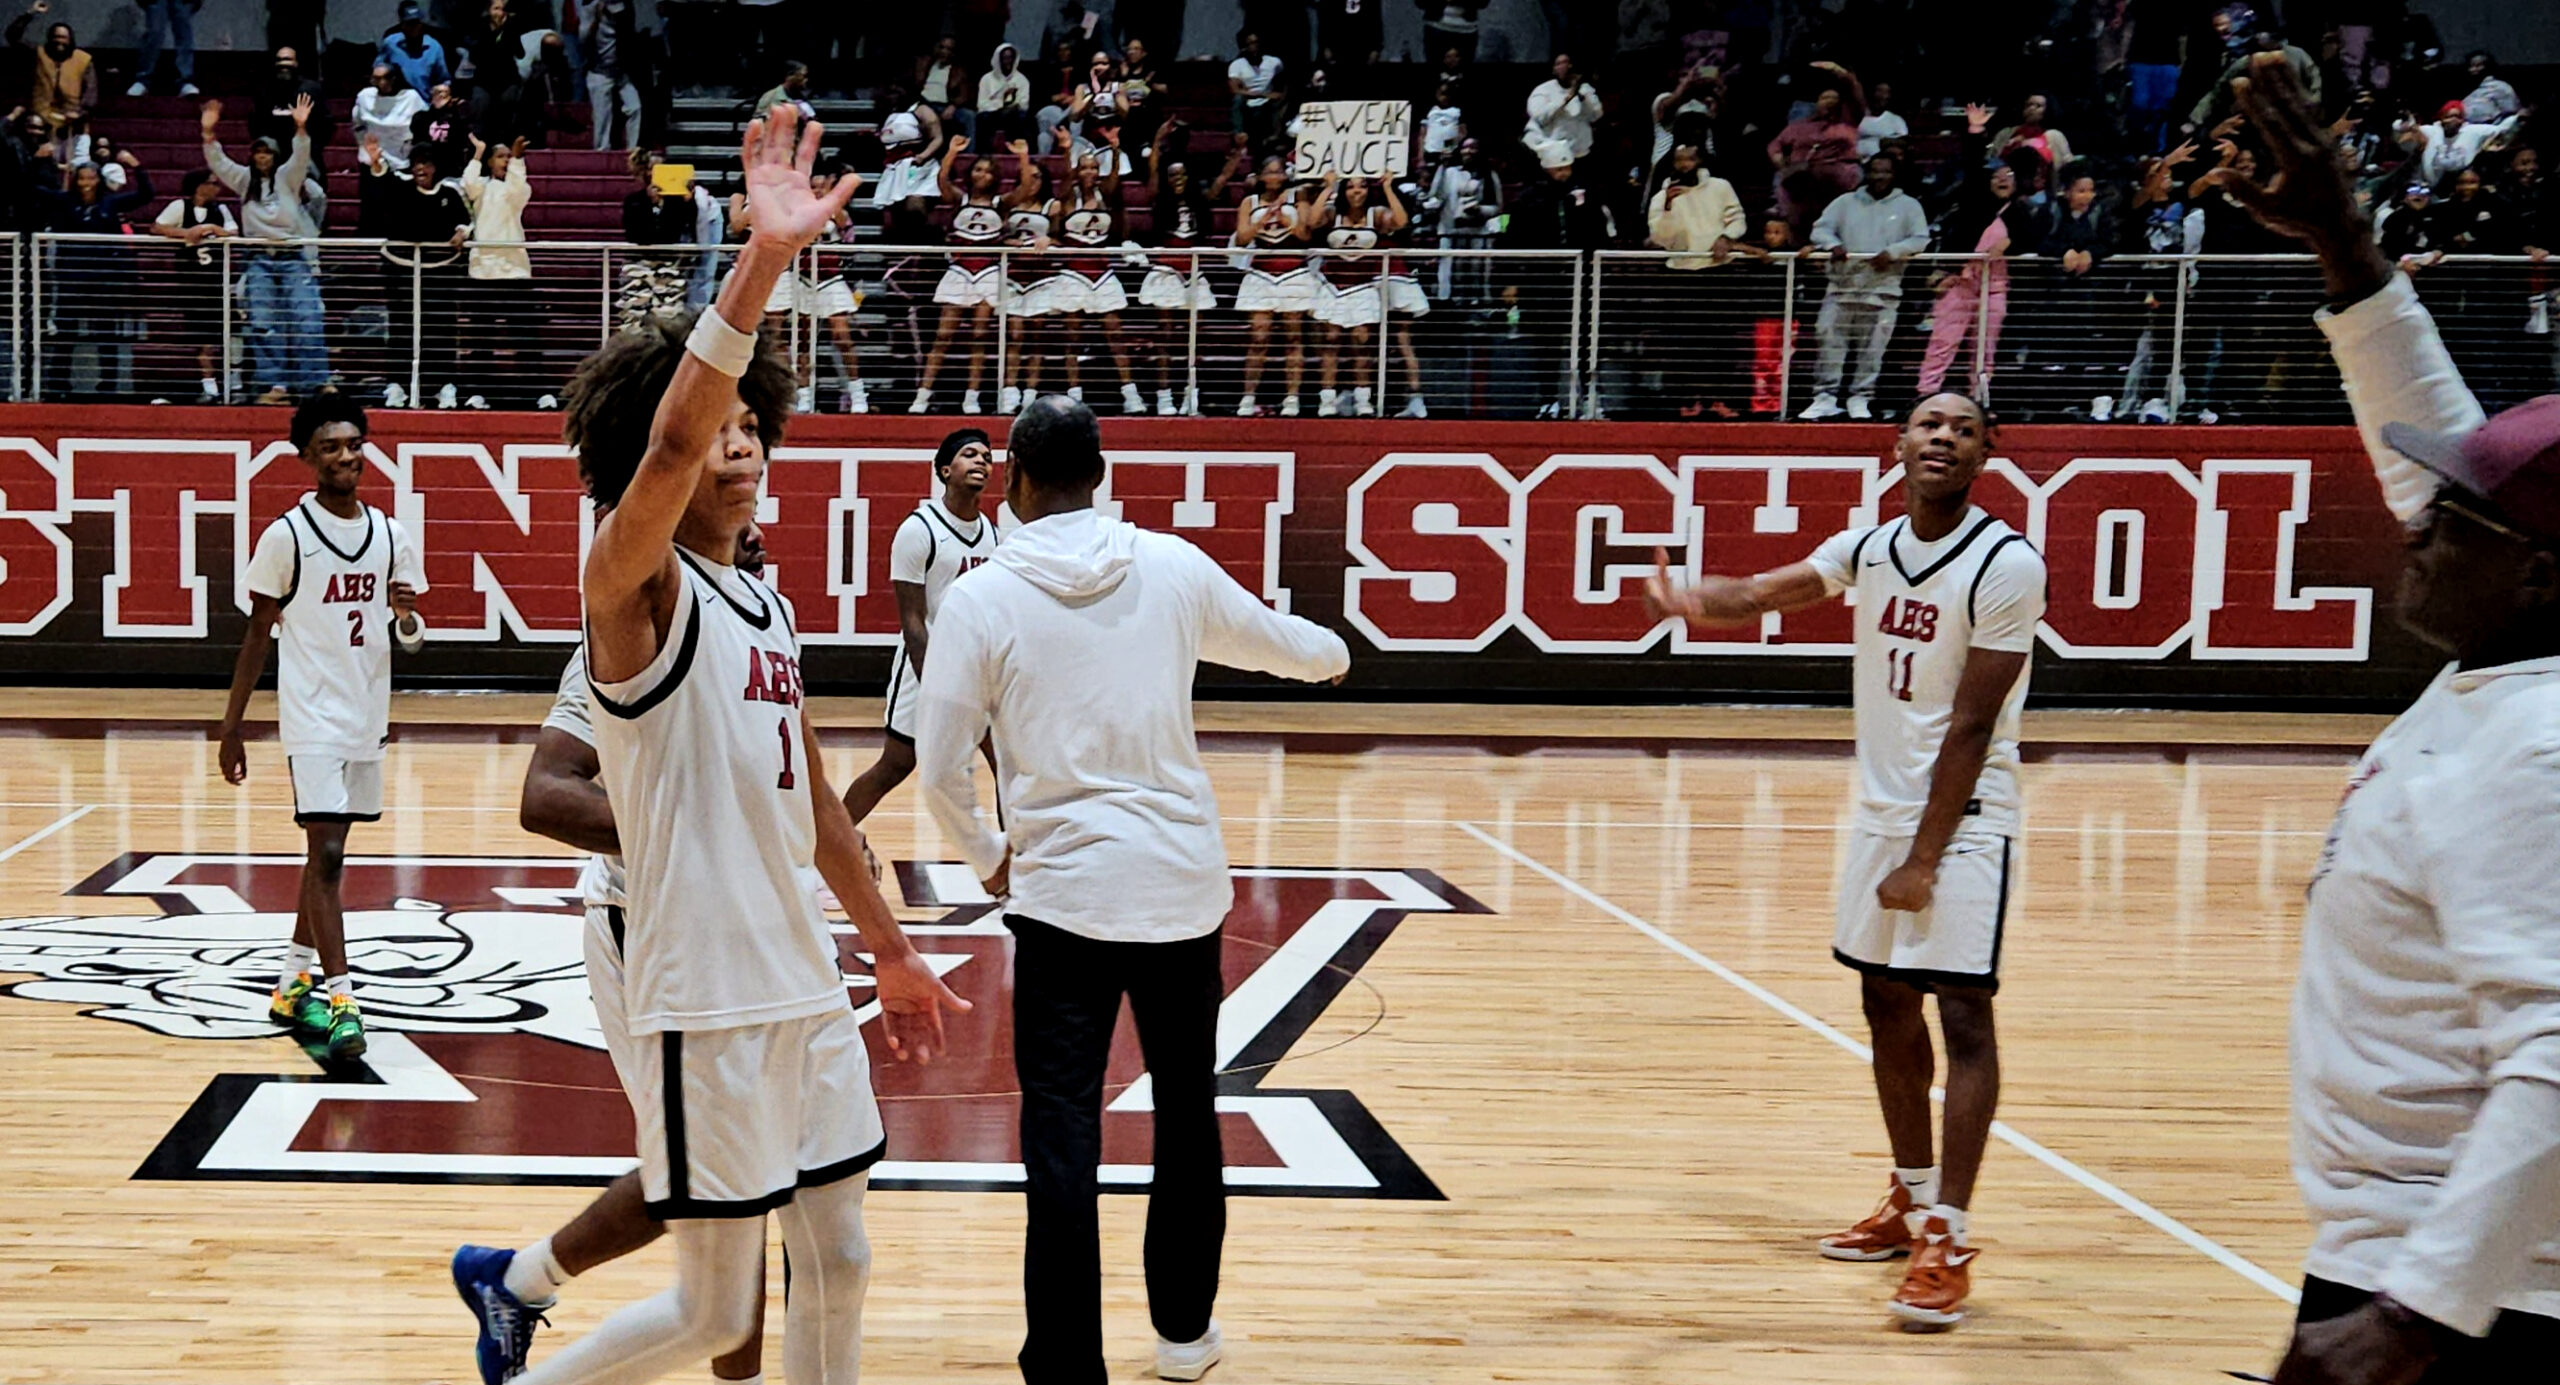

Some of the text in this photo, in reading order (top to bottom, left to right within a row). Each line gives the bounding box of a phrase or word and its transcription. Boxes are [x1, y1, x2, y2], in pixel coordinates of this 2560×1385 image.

[1300, 102, 1411, 137] #WEAK
[1297, 141, 1403, 175] SAUCE
[322, 572, 376, 604] AHS
[347, 609, 365, 648] 2
[1879, 596, 1940, 643] AHS
[1889, 648, 1916, 702] 11
[777, 716, 795, 790] 1
